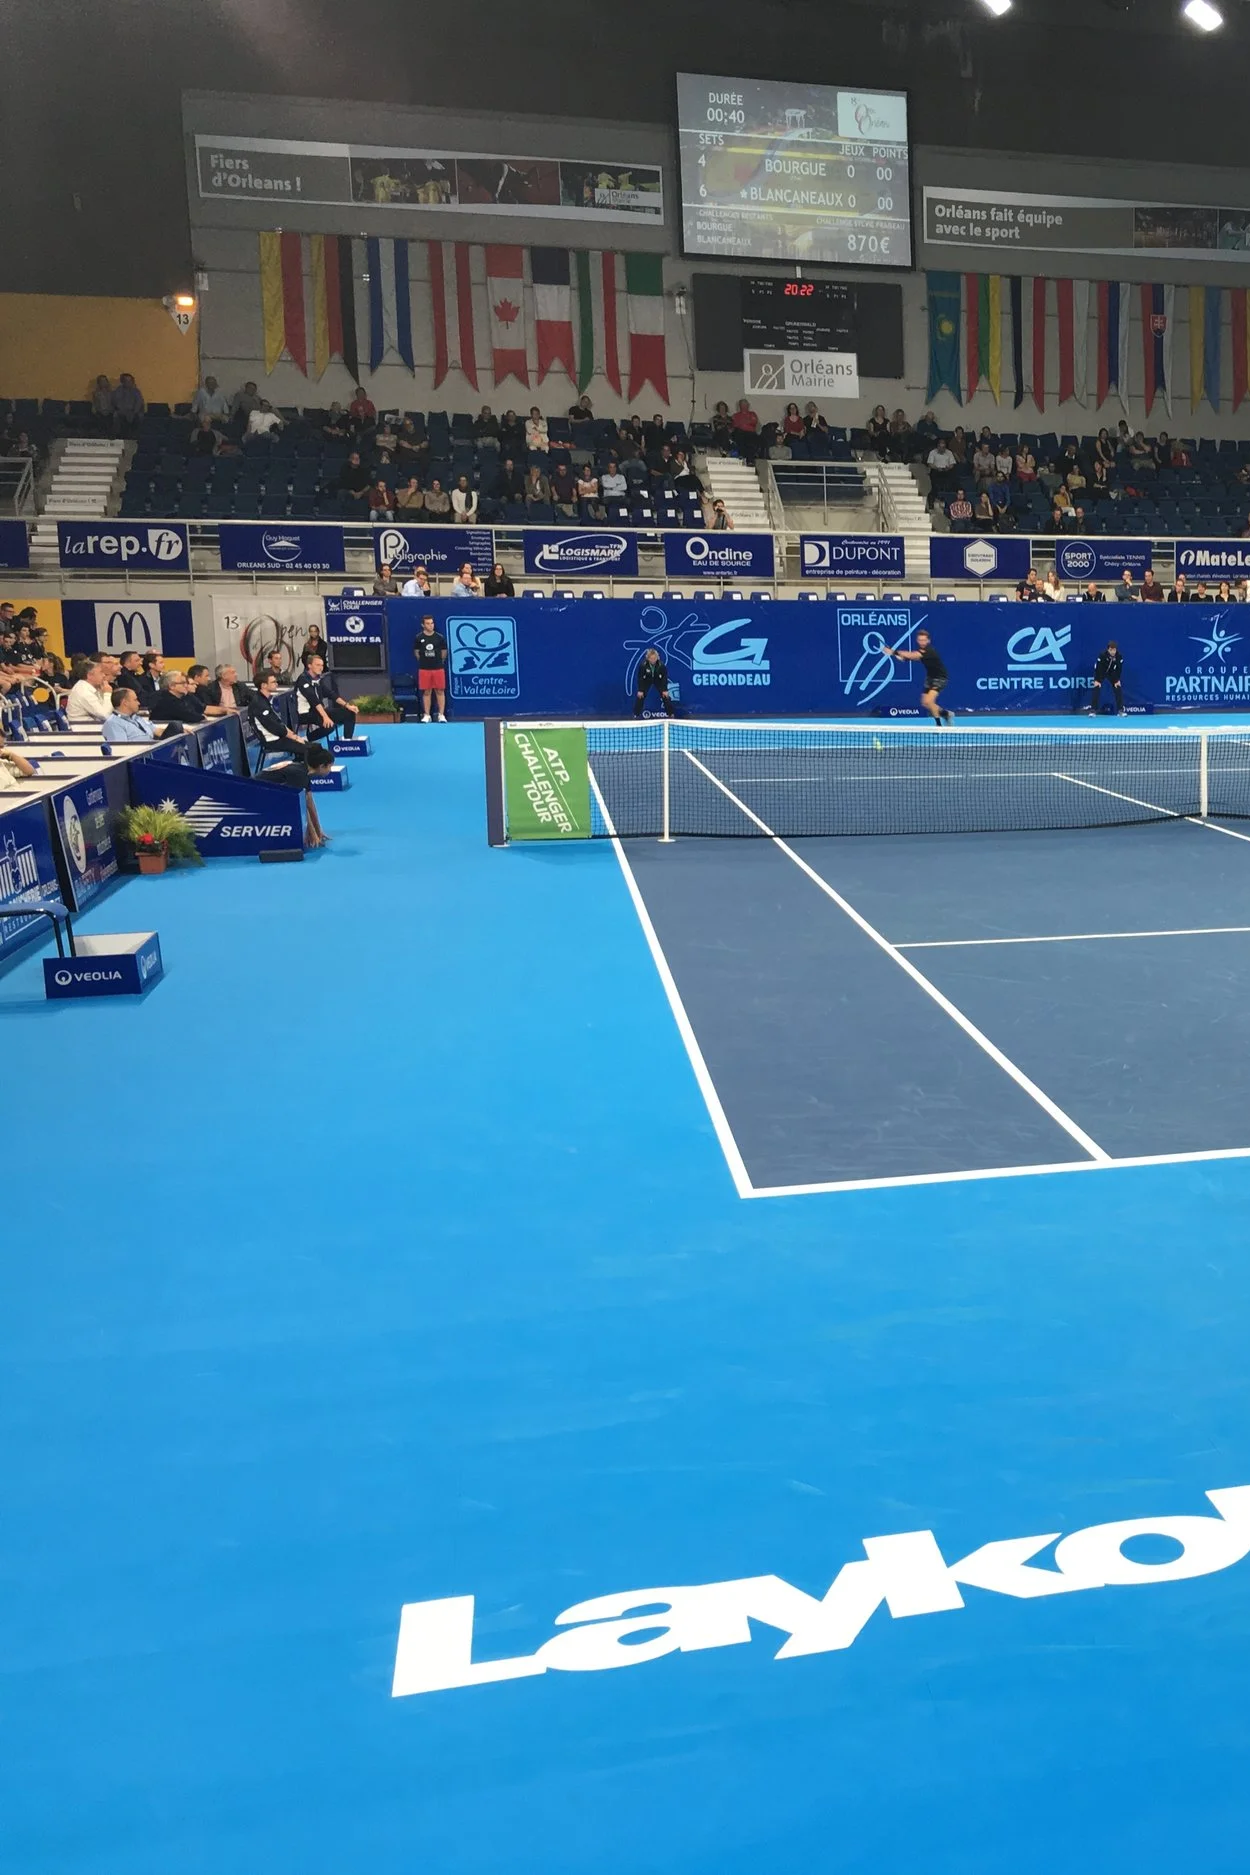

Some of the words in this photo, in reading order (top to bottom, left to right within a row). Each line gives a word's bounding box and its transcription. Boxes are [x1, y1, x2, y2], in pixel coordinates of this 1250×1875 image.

[708, 92, 744, 106] DURÉE
[706, 107, 746, 124] 00:40
[698, 134, 725, 146] SETS
[839, 144, 865, 157] JEUX
[872, 146, 909, 160] POINTS
[210, 153, 250, 170] Fiers
[698, 153, 706, 168] 4
[765, 159, 827, 177] BOURGUE
[847, 164, 856, 178] 0
[876, 167, 893, 181] 00
[699, 184, 707, 197] 6
[750, 187, 843, 208] BLANCANEAUX
[848, 194, 856, 208] 0
[877, 197, 893, 211] 00
[934, 203, 987, 221] Orléans
[989, 206, 1014, 223] fait
[1016, 209, 1063, 228] équipe
[696, 221, 733, 232] BOURGUE
[934, 222, 967, 238] avec
[969, 222, 981, 237] le
[983, 225, 1021, 241] sport
[696, 234, 752, 246] BLANCANEAUX
[176, 313, 190, 325] 13
[790, 358, 853, 376] Orléans
[790, 373, 835, 388] Mairie
[560, 547, 621, 557] LOGISMARK
[685, 536, 753, 561] Ondine
[832, 546, 900, 560] DUPONT
[1064, 552, 1093, 561] SPORT
[1066, 560, 1090, 568] 2000
[871, 568, 902, 576] décoration
[224, 615, 241, 630] 13
[841, 611, 908, 626] ORLÉANS
[1184, 666, 1249, 674] GROUPE
[471, 676, 508, 685] Centre-
[692, 673, 771, 686] GERONDEAU
[976, 677, 1044, 690] CENTRE
[1049, 676, 1096, 689] LOIRE
[463, 686, 479, 695] Val
[480, 686, 491, 695] de
[492, 685, 517, 695] Loire
[543, 747, 571, 784] ATP
[514, 733, 573, 833] CHALLENGER
[522, 780, 553, 824] TOUR
[219, 824, 293, 838] SERVIER
[73, 970, 122, 982] VEOLIA
